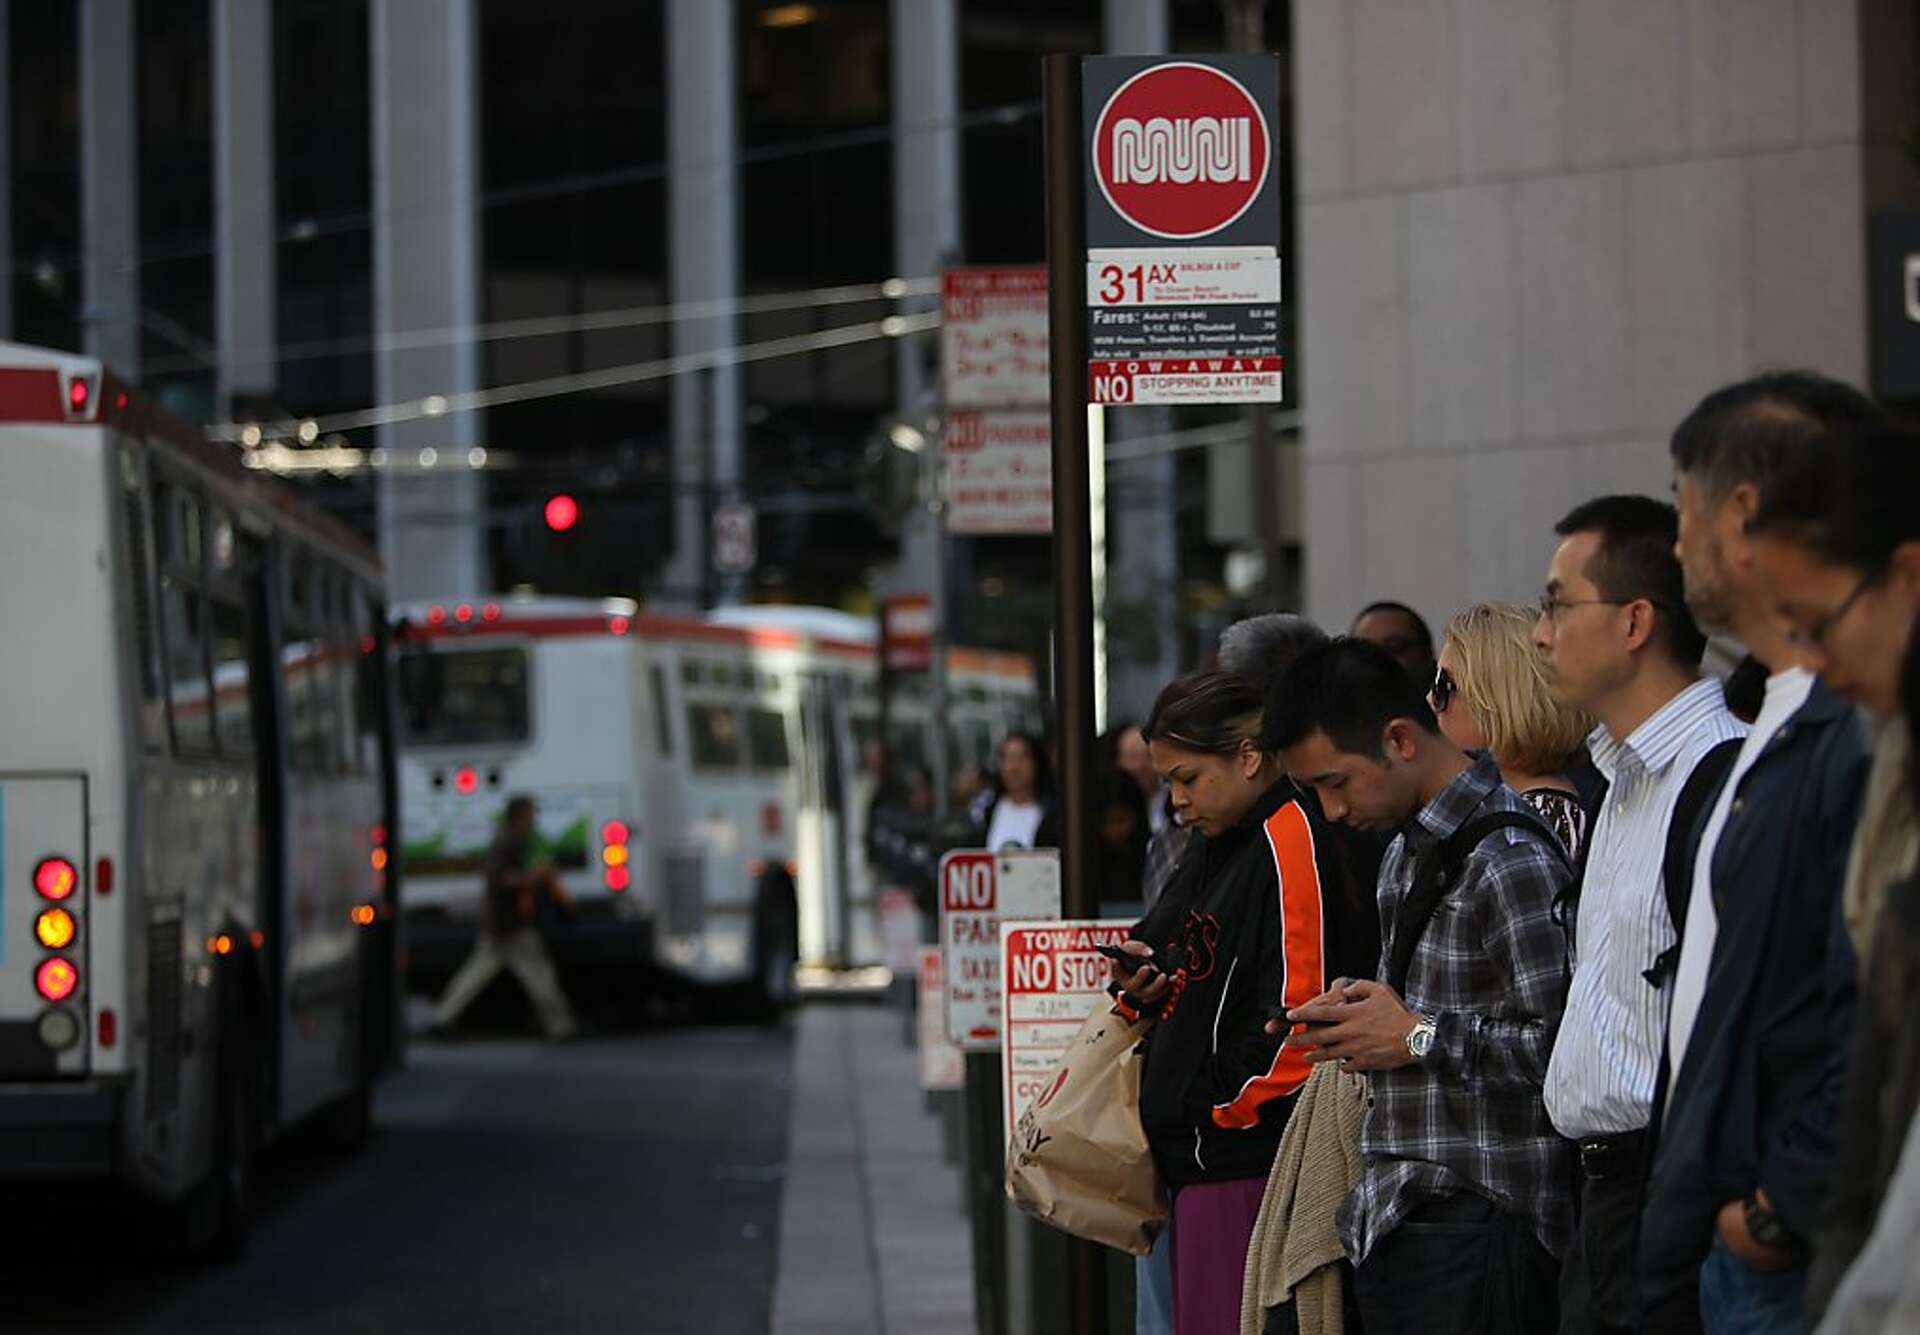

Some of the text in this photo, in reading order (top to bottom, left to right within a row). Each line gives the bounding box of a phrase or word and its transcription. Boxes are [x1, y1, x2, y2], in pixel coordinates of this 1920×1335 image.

[1112, 116, 1250, 184] MUNI
[1093, 310, 1140, 324] Fares:
[1108, 360, 1263, 374] TOW-AWAY
[1094, 375, 1276, 402] NO STOPPING ANYTIME
[951, 862, 991, 907] NO
[1013, 953, 1052, 989] NO
